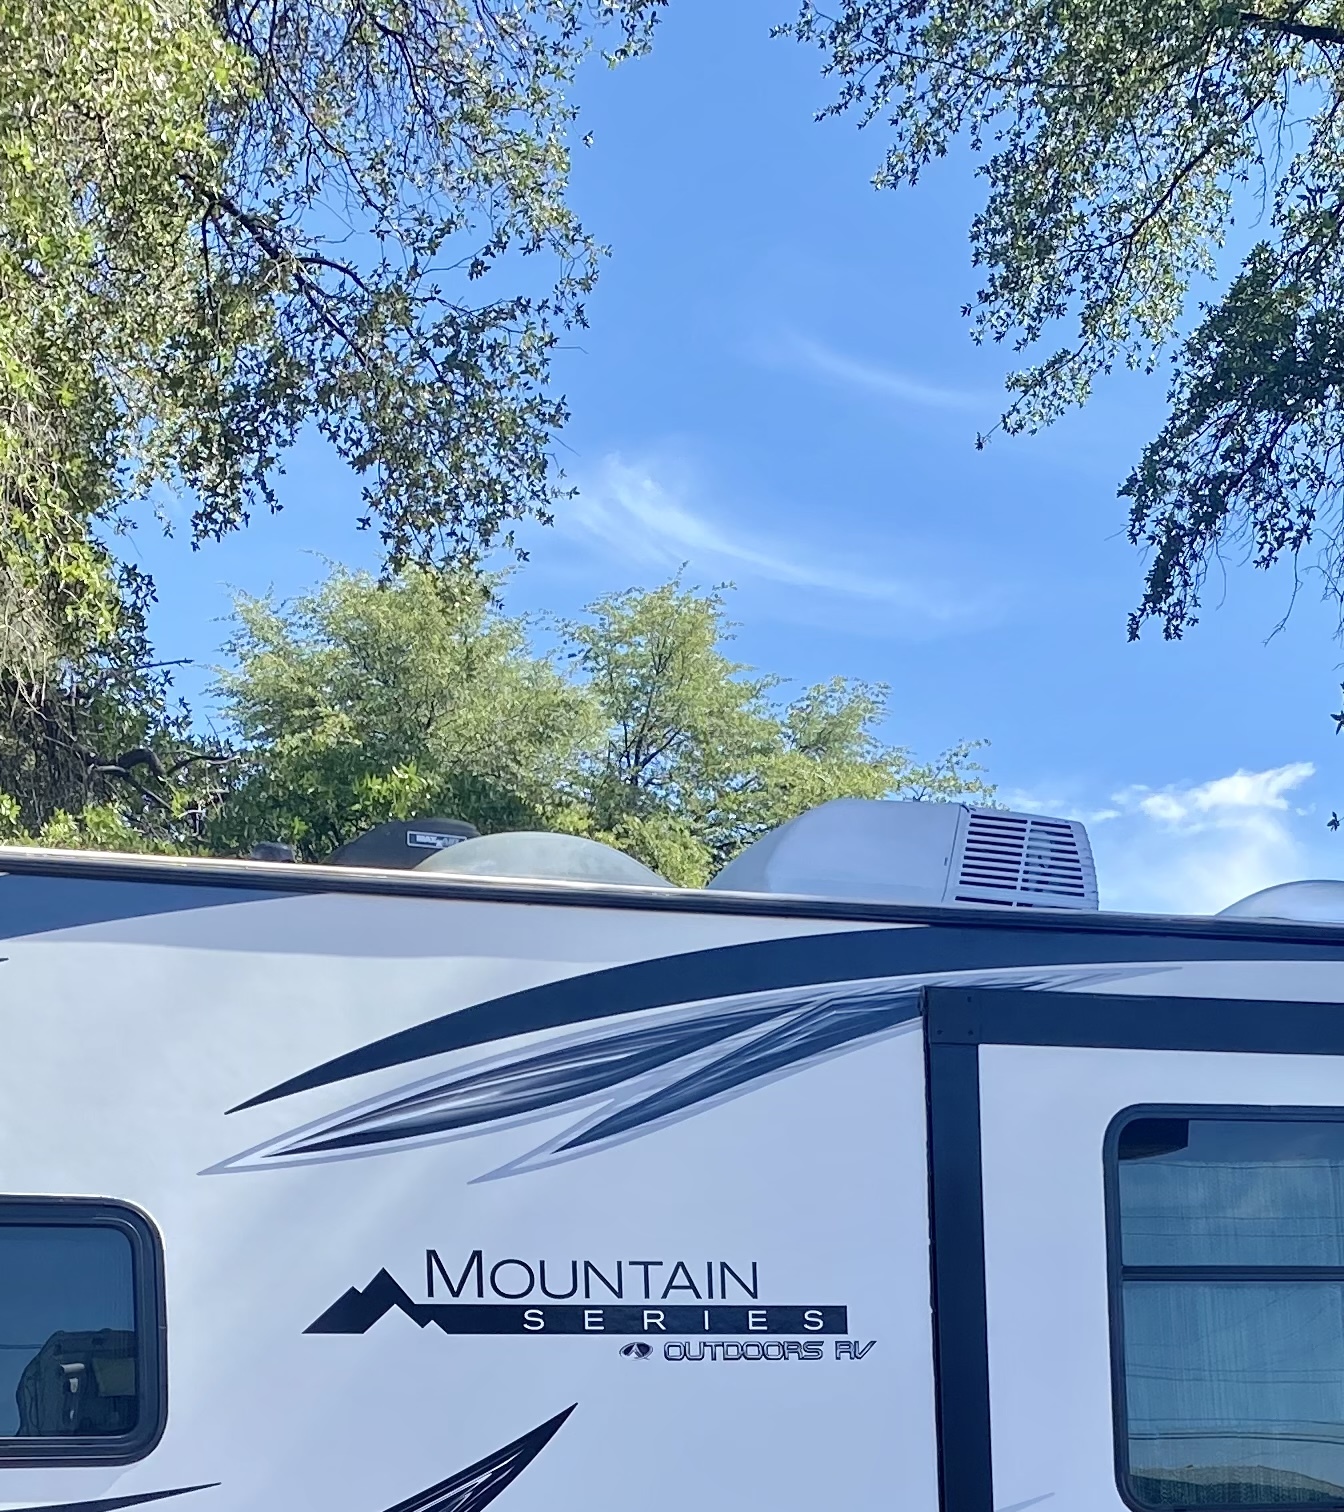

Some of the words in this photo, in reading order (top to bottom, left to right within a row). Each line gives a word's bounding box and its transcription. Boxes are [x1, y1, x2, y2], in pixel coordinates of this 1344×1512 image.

[425, 1249, 758, 1300] MOUNTAIN
[523, 1309, 824, 1331] SERIES
[664, 1340, 824, 1361] OUTDOORS
[834, 1340, 877, 1361] RV
